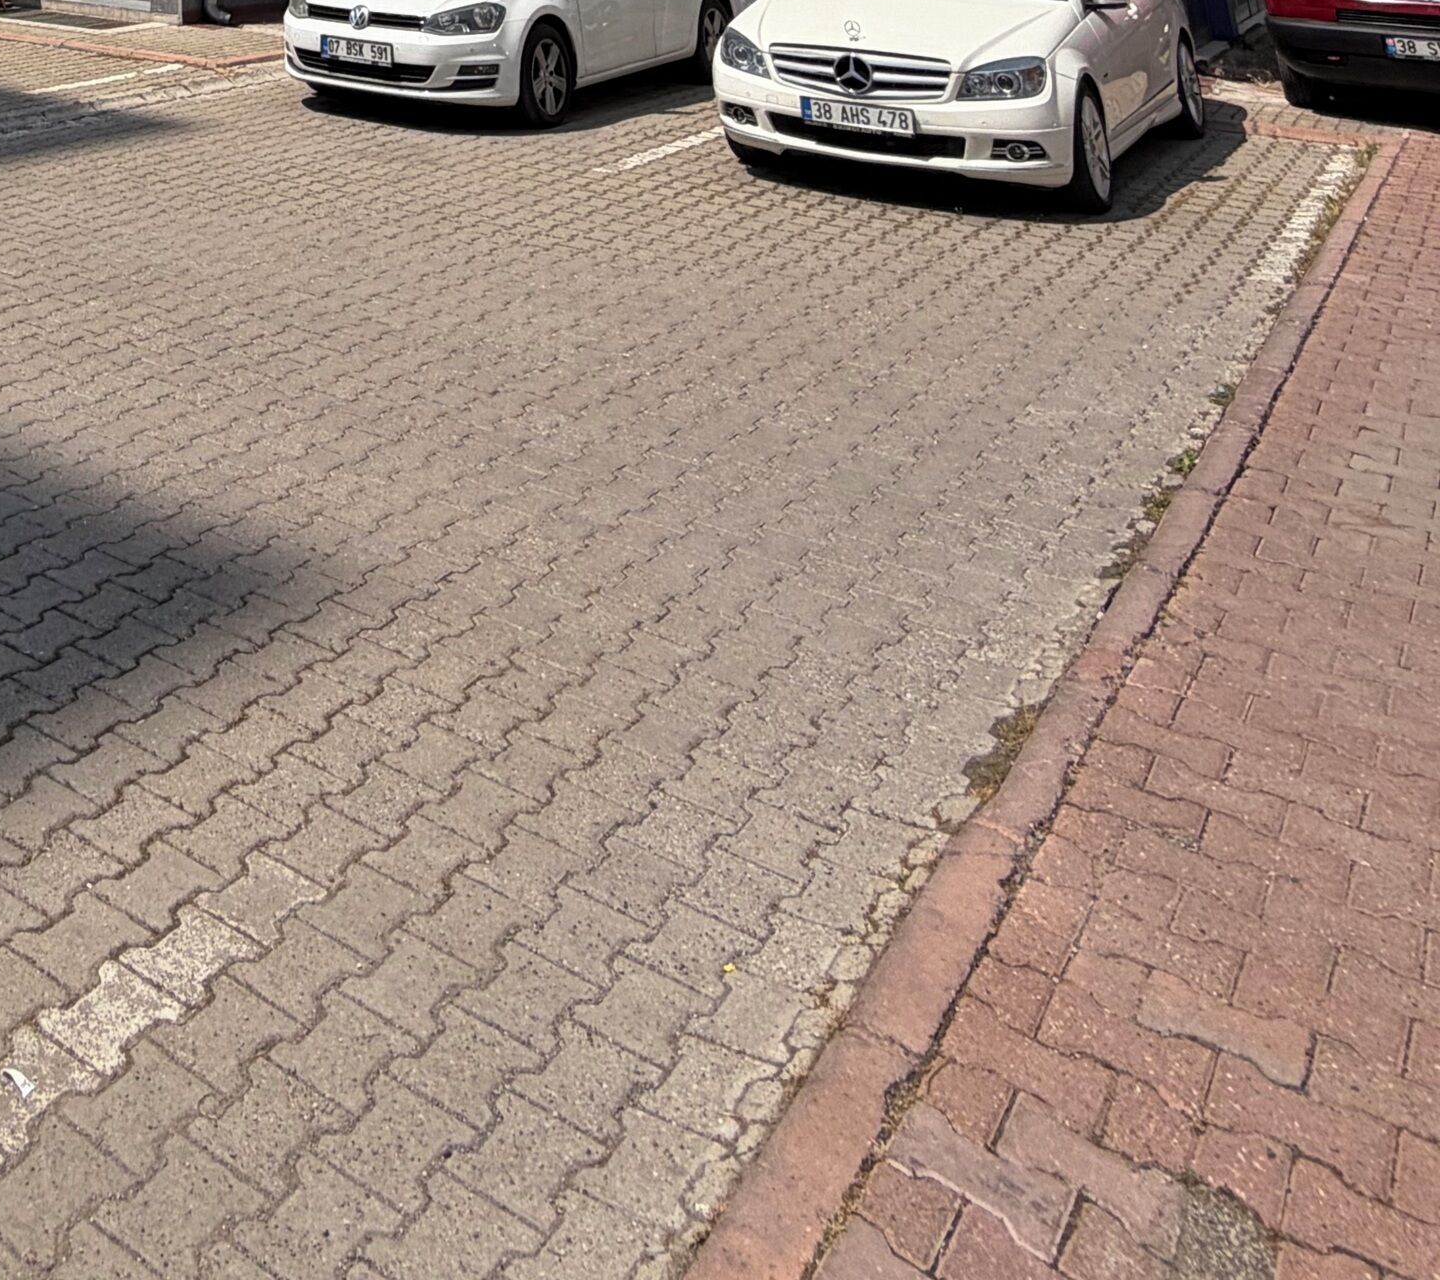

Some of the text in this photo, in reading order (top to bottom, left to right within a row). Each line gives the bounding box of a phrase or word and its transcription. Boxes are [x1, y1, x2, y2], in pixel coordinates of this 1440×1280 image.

[328, 40, 388, 61] 07 BSK 591
[1396, 39, 1440, 56] 38 S
[813, 101, 833, 121] 38
[840, 105, 871, 126] AHS
[877, 110, 909, 131] 478
